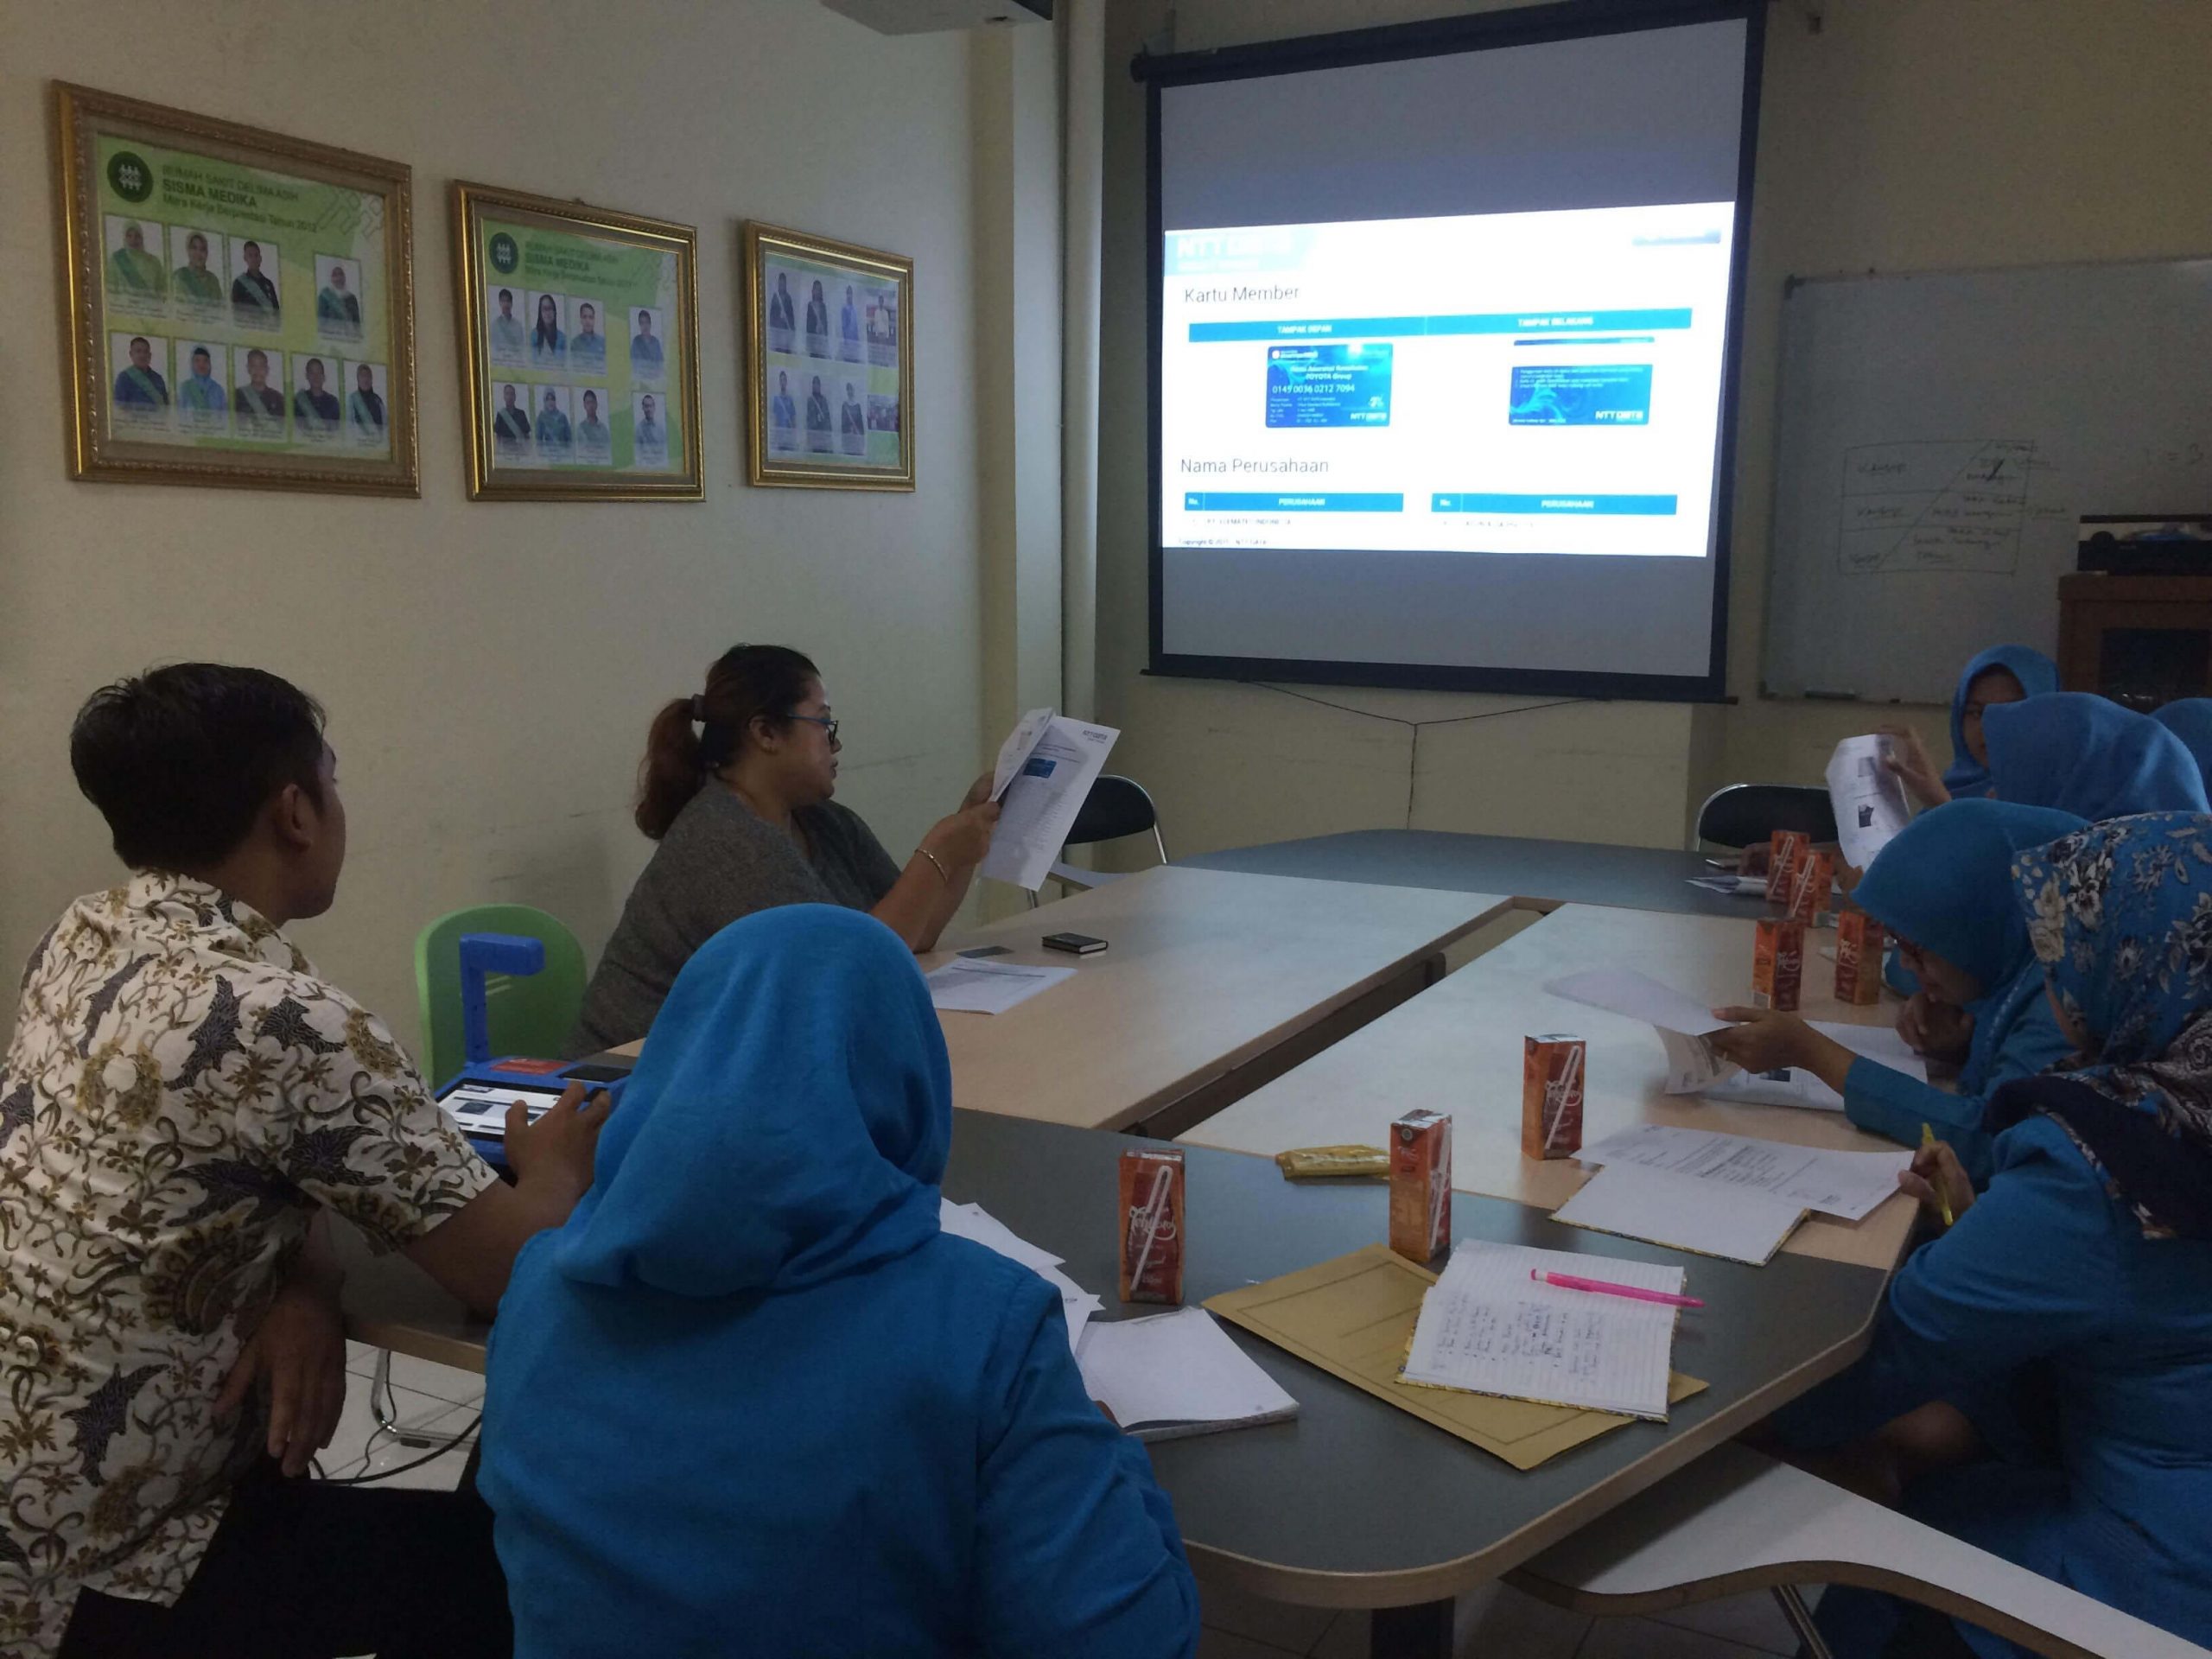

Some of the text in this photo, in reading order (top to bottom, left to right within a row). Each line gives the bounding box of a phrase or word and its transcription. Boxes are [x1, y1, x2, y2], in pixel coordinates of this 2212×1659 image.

[162, 178, 257, 207] SISMA MEDIKA
[1185, 284, 1300, 303] Kartu Member
[1180, 456, 1330, 475] Nama Perusahaan
